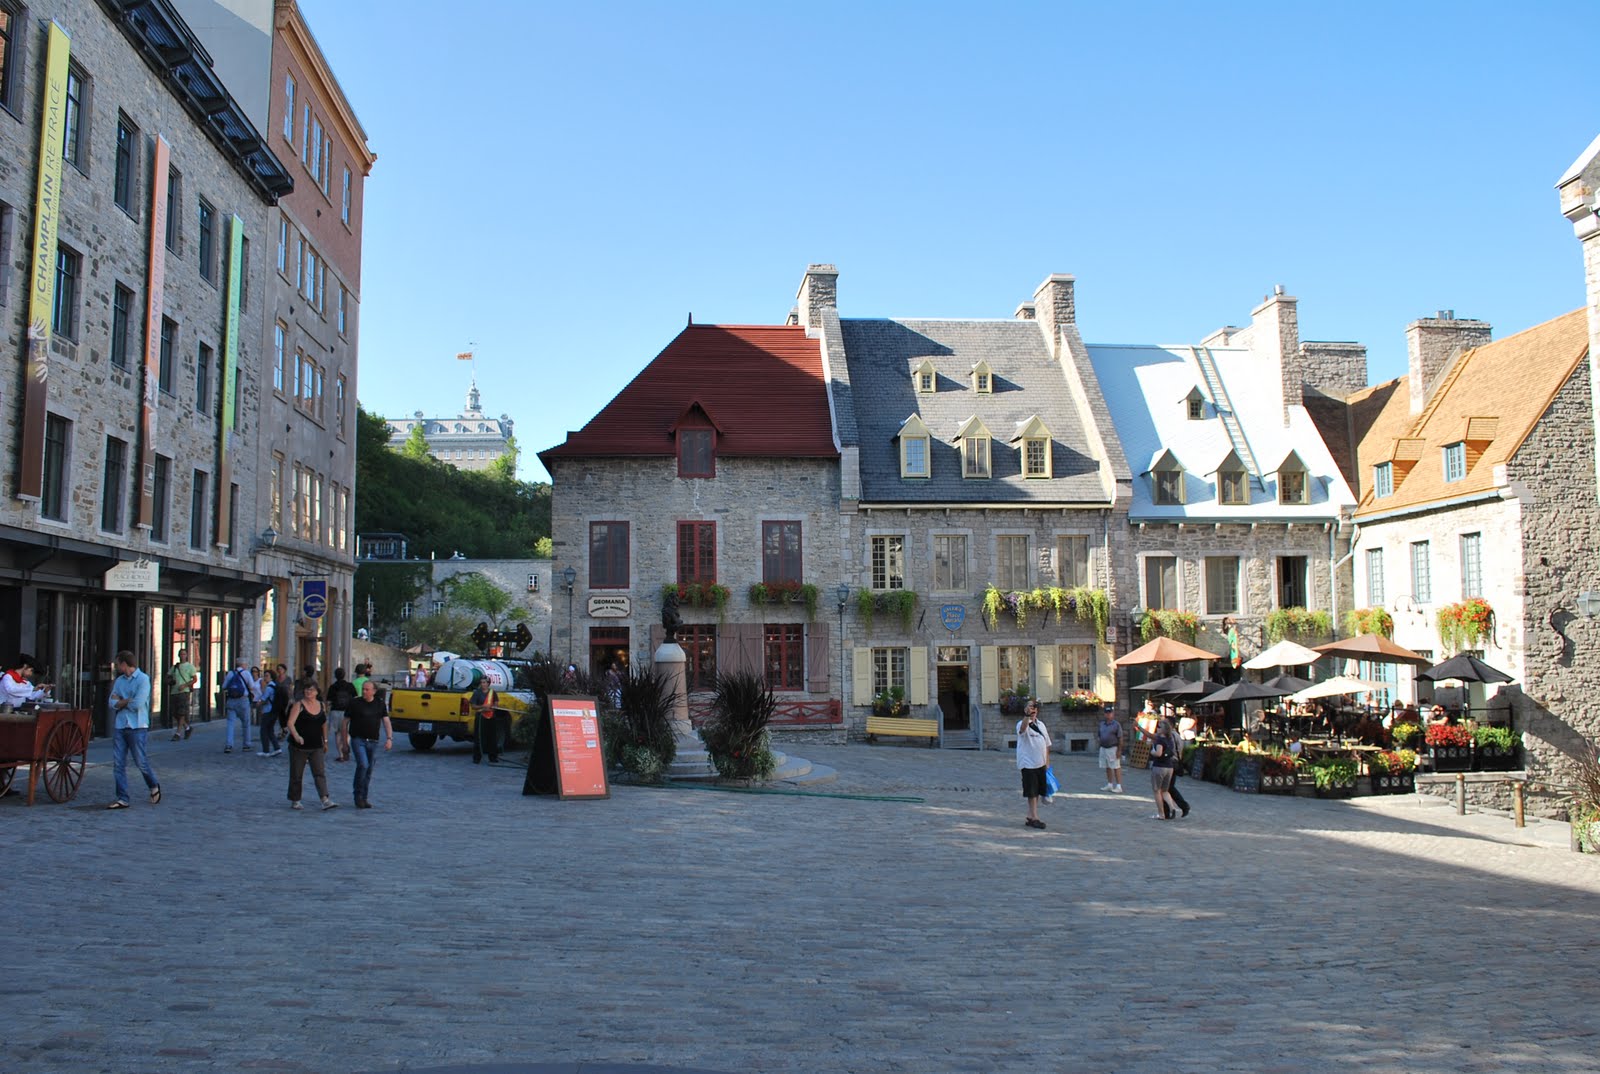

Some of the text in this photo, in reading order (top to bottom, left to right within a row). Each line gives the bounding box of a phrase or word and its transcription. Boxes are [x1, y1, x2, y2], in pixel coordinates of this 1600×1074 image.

[37, 76, 60, 295] CHAMPLAIN RETRACÉ
[150, 287, 158, 324] ANS
